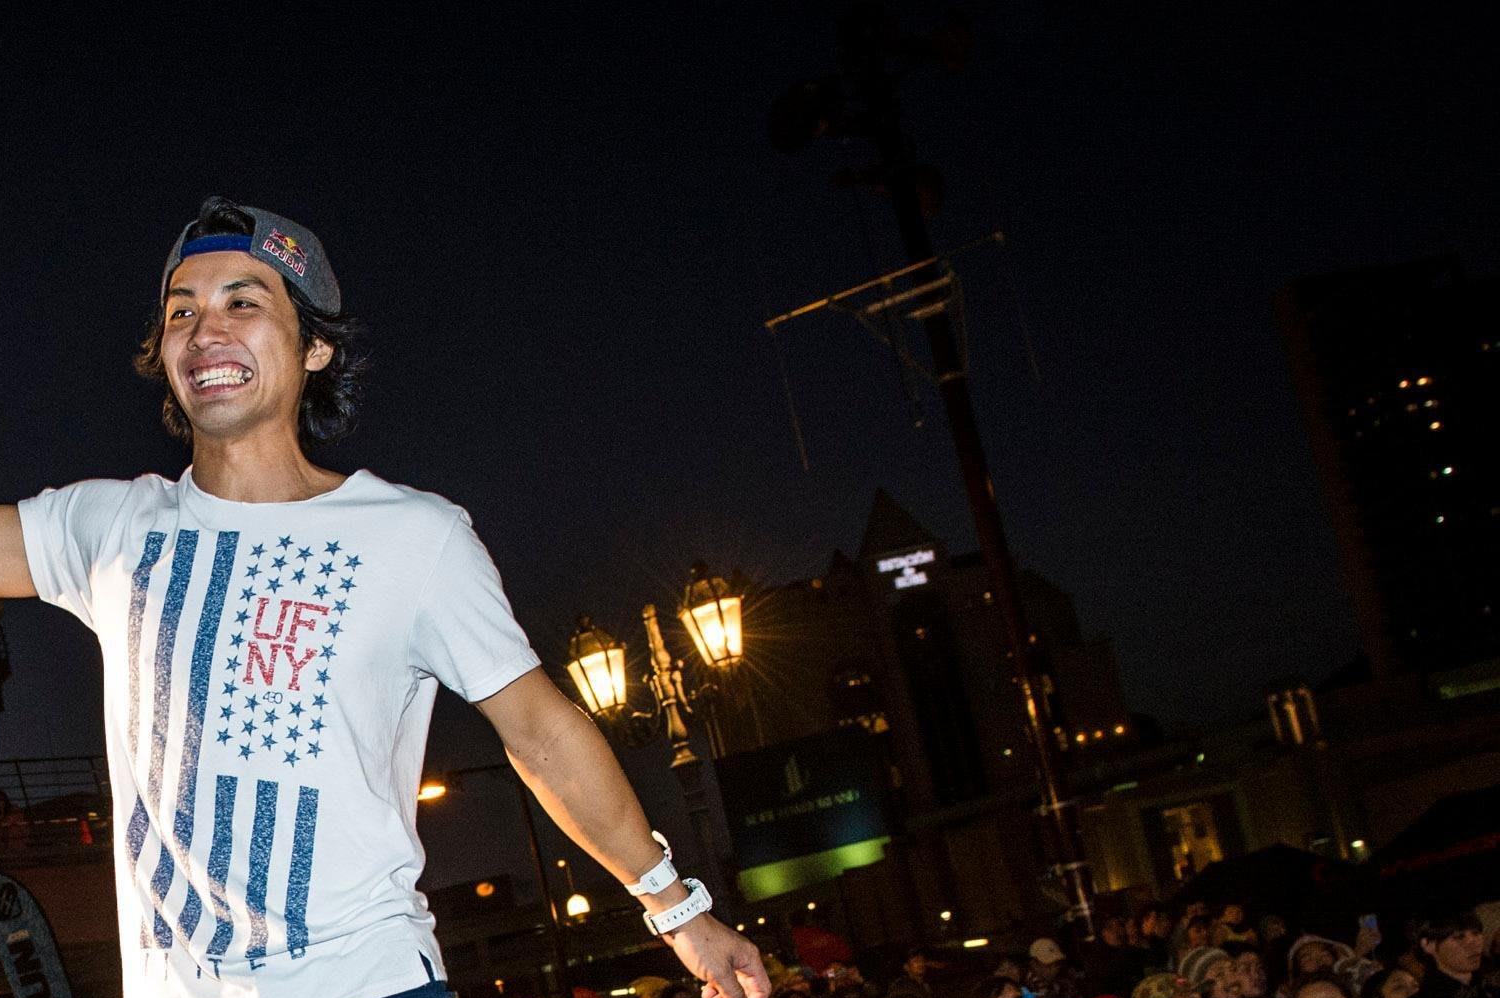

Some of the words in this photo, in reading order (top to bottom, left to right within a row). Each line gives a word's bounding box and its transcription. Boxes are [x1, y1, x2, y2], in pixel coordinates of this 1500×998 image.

[262, 238, 287, 262] Red
[252, 597, 330, 643] UF
[242, 641, 318, 691] NY
